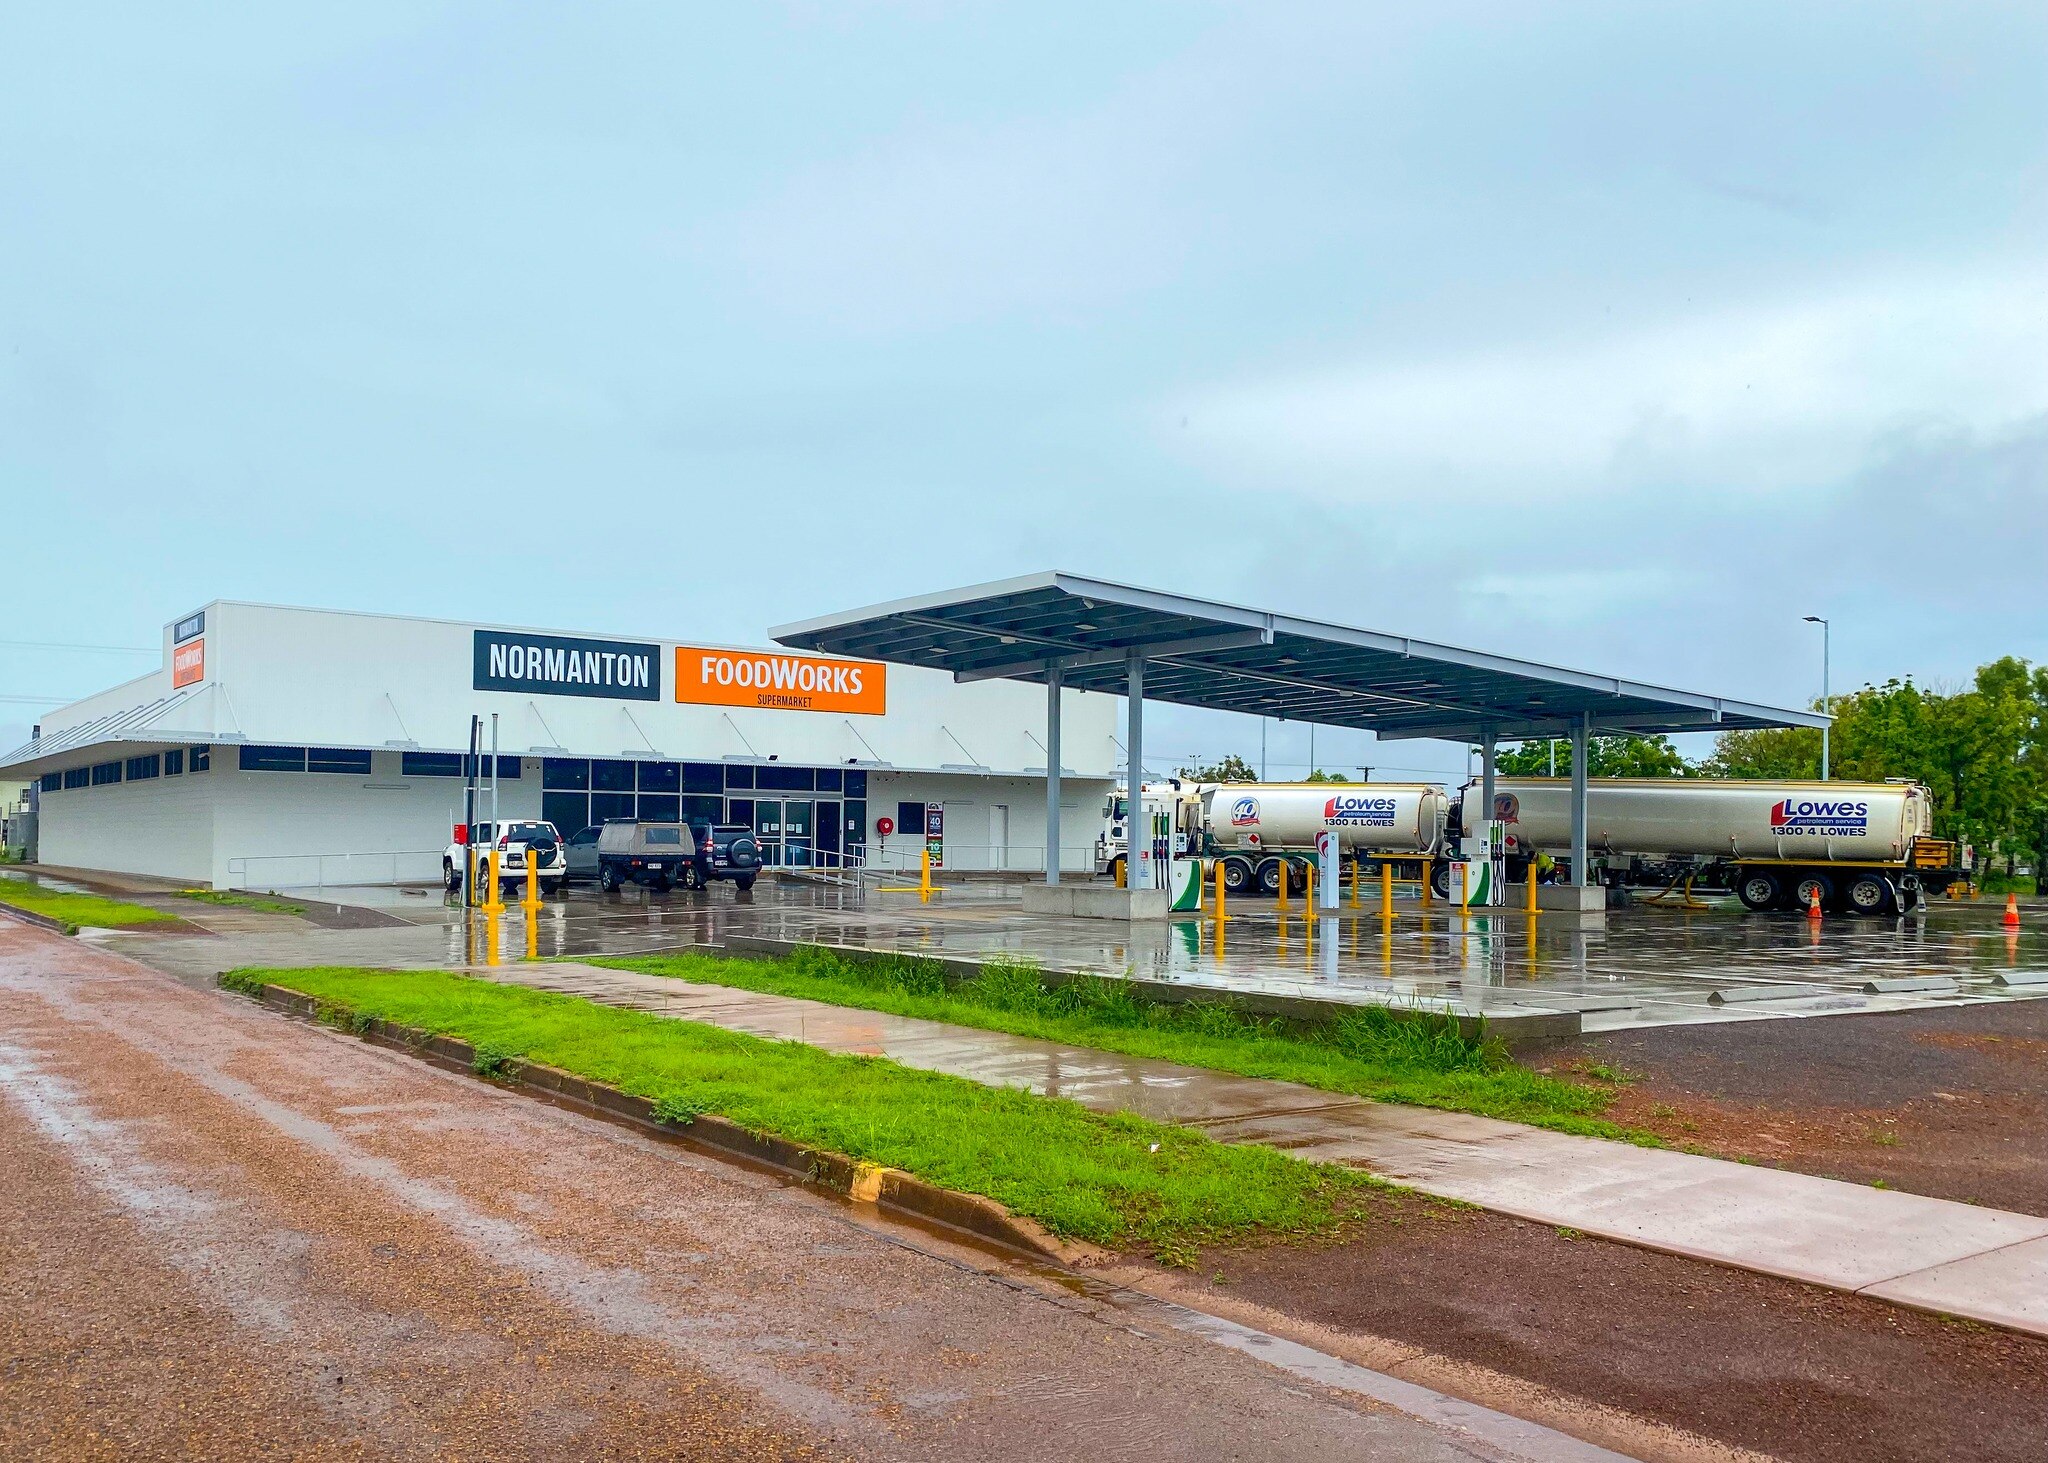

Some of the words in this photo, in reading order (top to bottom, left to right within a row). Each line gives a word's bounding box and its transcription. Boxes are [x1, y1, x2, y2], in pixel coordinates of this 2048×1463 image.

[489, 643, 649, 688] NORMANTON
[757, 693, 813, 708] SUPERMARKET
[1324, 818, 1348, 826] 1300
[1360, 819, 1395, 827] LOWES
[1770, 826, 1804, 836] 1300
[1807, 827, 1816, 836] 4
[1820, 827, 1867, 837] LOWES
